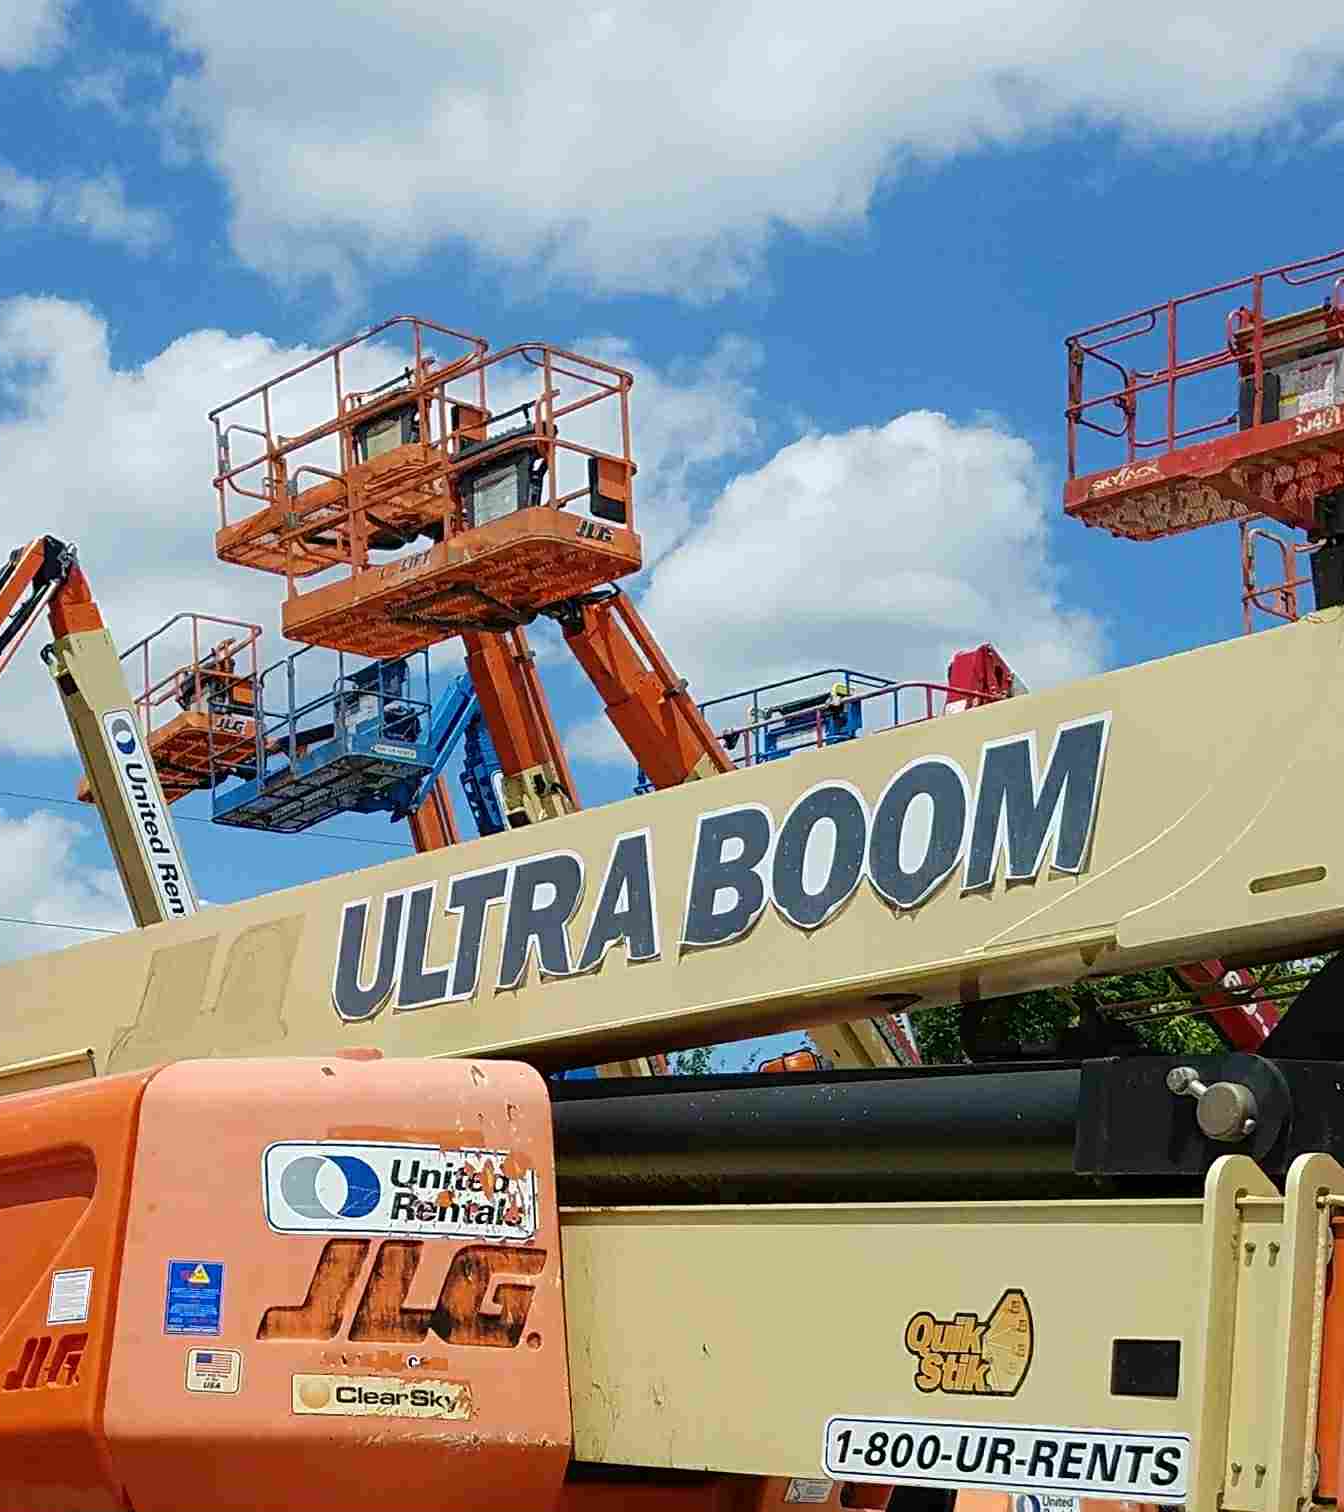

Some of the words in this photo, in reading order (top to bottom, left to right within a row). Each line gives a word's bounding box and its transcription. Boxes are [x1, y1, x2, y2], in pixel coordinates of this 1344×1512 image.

[215, 715, 245, 732] JLG
[125, 762, 170, 855] United
[158, 863, 186, 916] Ren
[331, 827, 661, 1022] ULTRA
[680, 711, 1112, 946] BOOM
[905, 1312, 982, 1356] Quik
[914, 1353, 989, 1393] Stik
[335, 1385, 458, 1412] ClearSky
[835, 1428, 1183, 1487] 1-800-UR-RENTS
[1042, 1494, 1074, 1508] United
